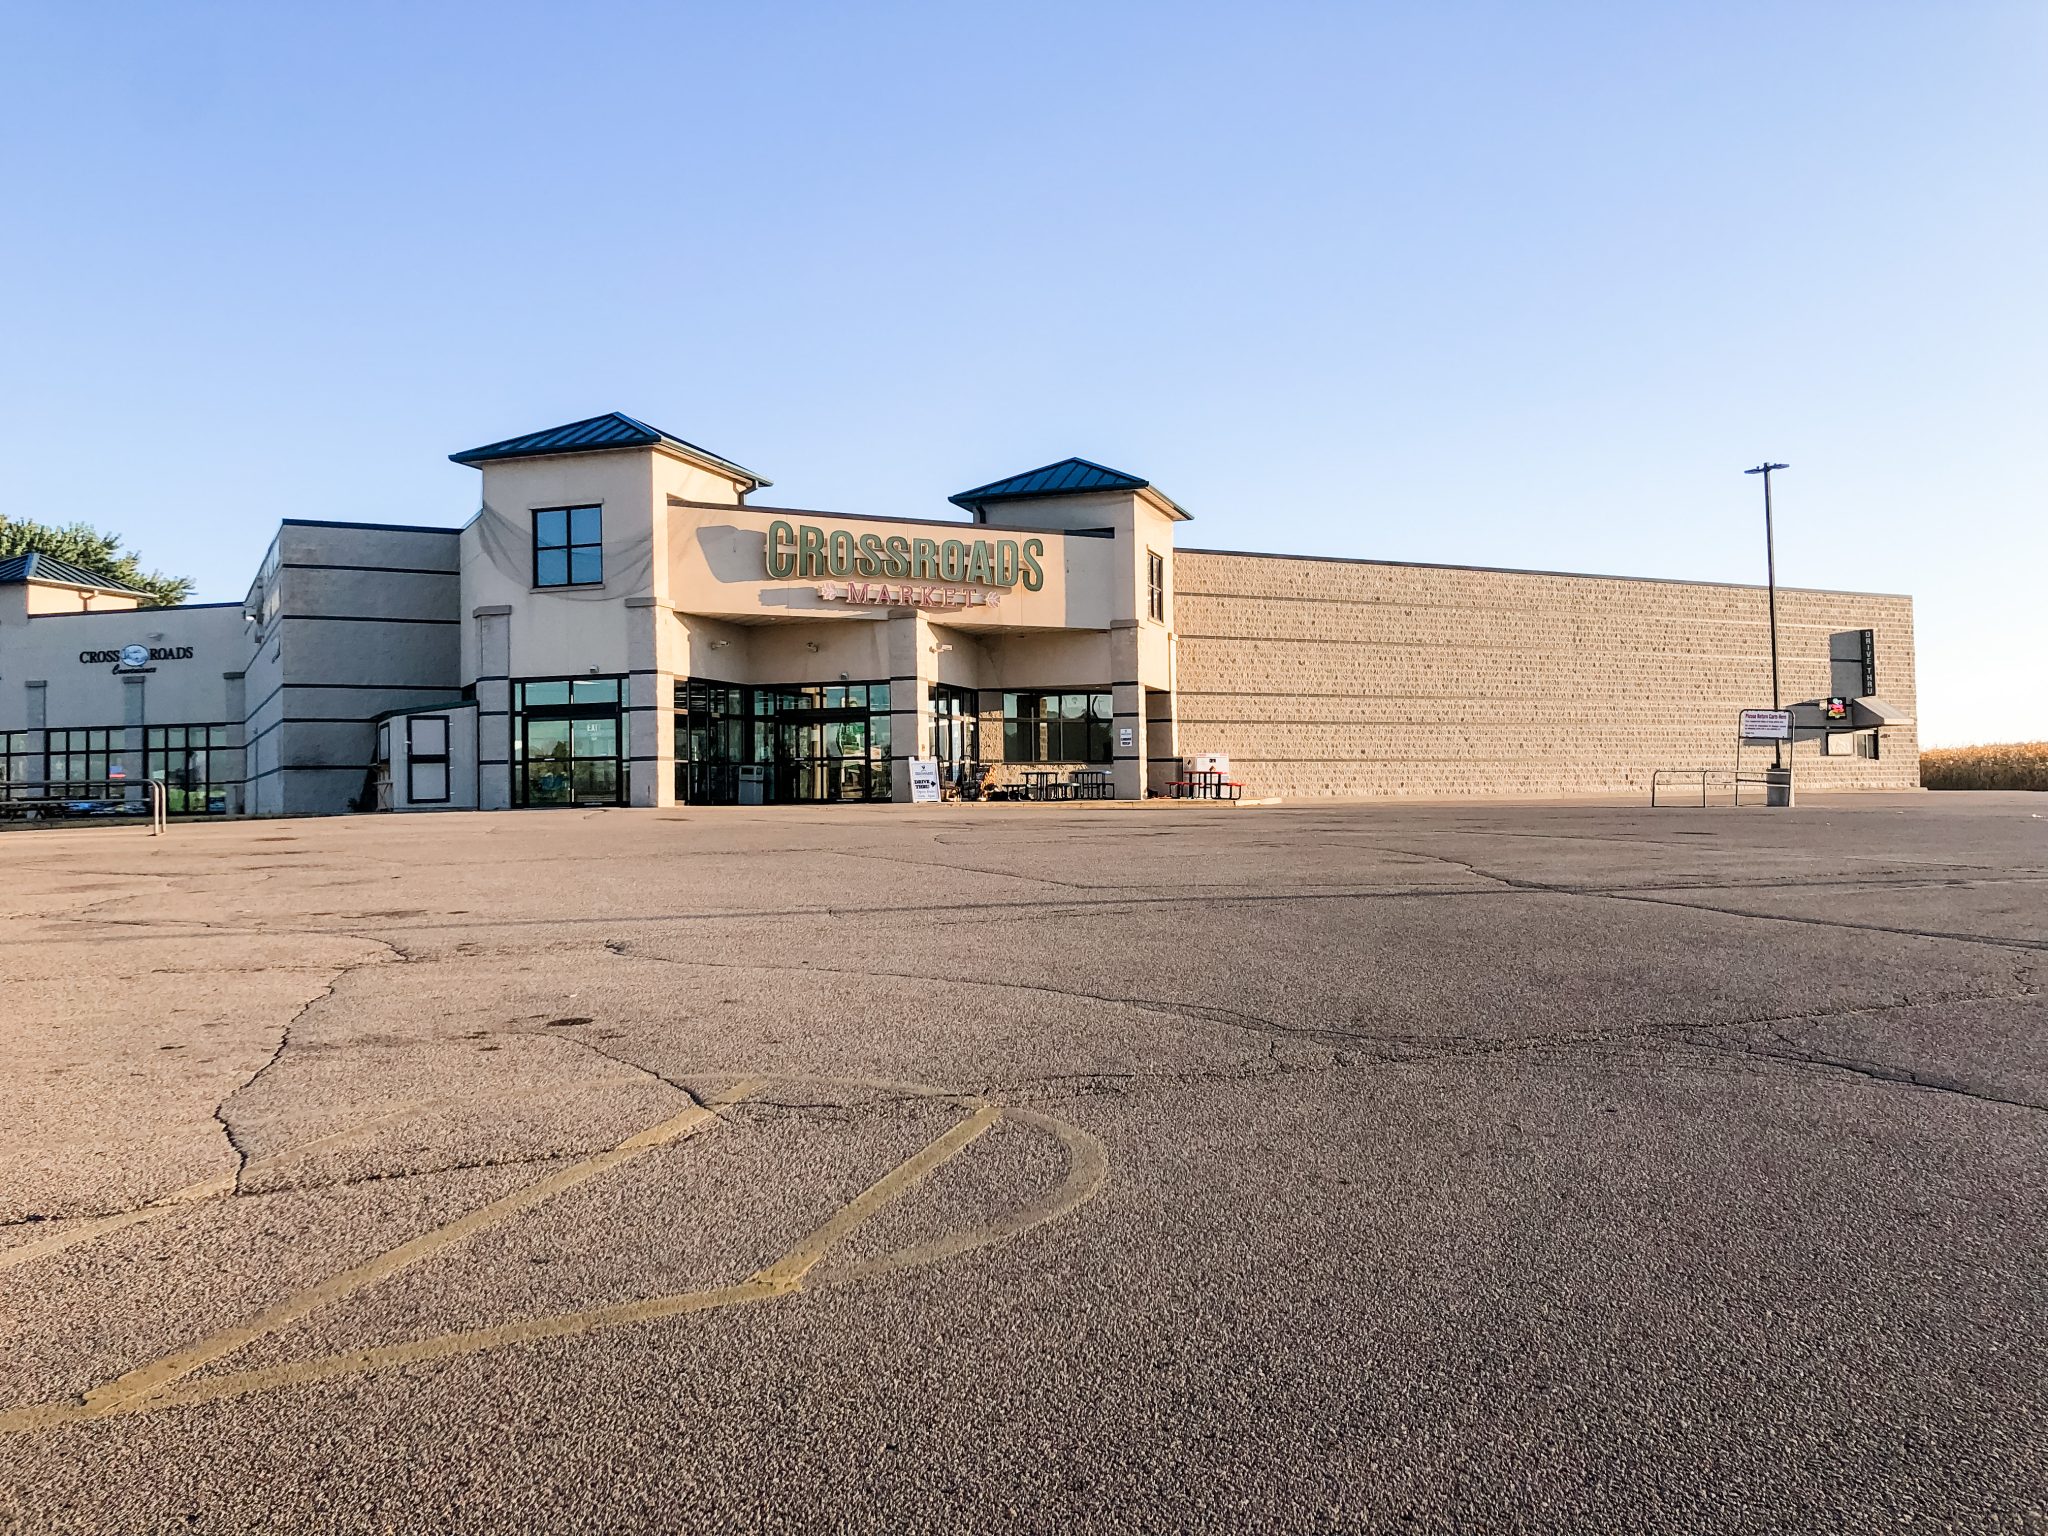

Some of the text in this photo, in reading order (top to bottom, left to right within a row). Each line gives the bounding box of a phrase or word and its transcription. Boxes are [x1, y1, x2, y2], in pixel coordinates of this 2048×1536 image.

[766, 520, 1044, 592] CROSSROADS
[846, 582, 977, 608] MARKET
[79, 646, 194, 664] CROSS ROADS
